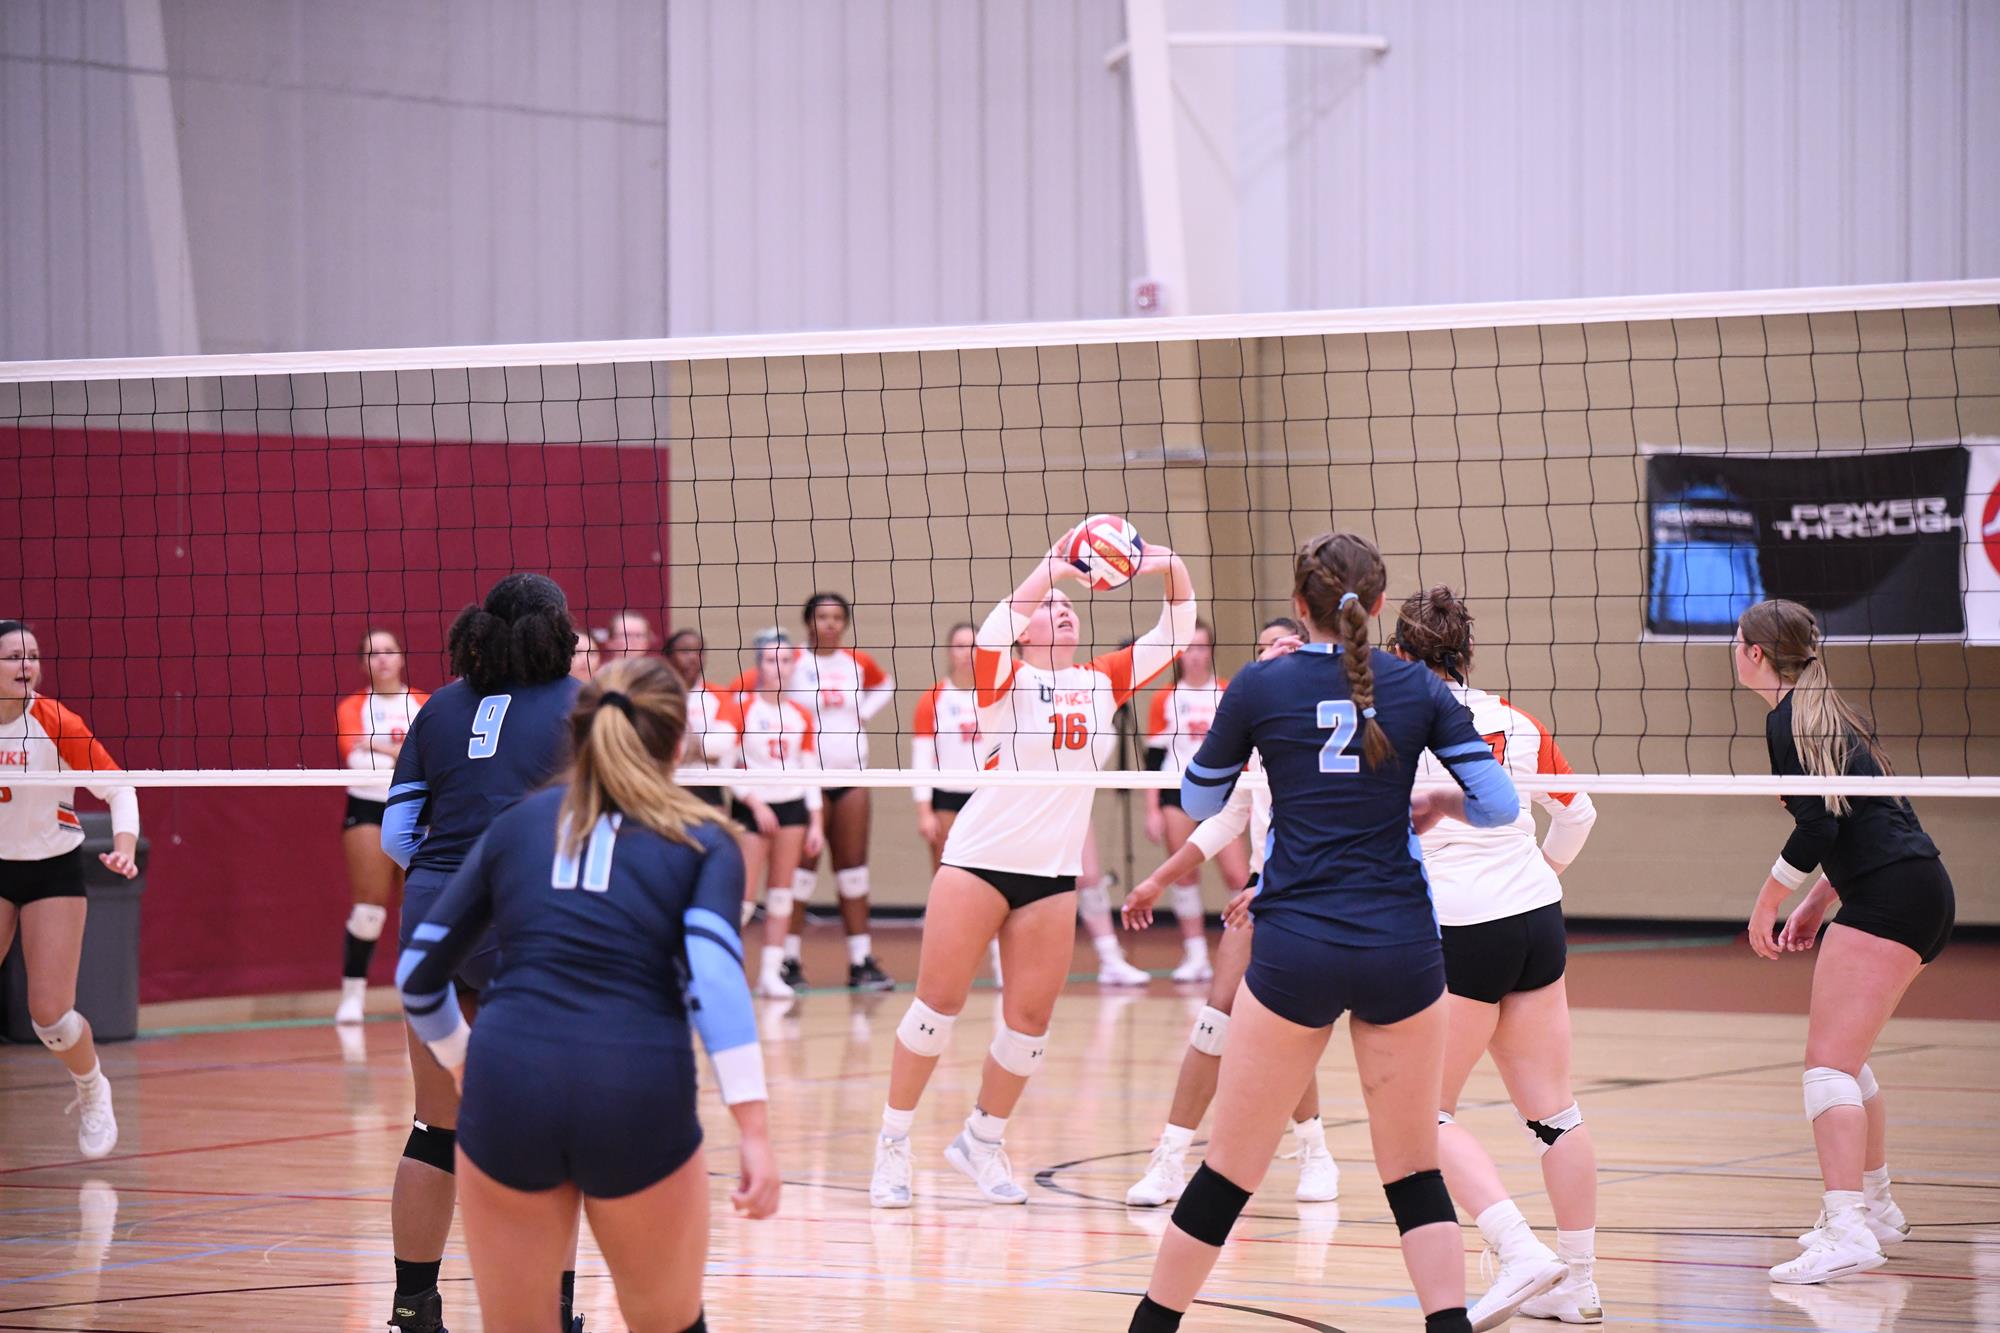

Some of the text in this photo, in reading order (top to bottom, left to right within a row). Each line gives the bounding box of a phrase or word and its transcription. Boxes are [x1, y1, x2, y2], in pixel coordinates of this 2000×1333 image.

[1773, 511, 1963, 541] THROUGH
[1790, 496, 1948, 525] POWER
[468, 694, 512, 759] 9
[1048, 712, 1088, 751] 16
[1316, 699, 1360, 773] 2
